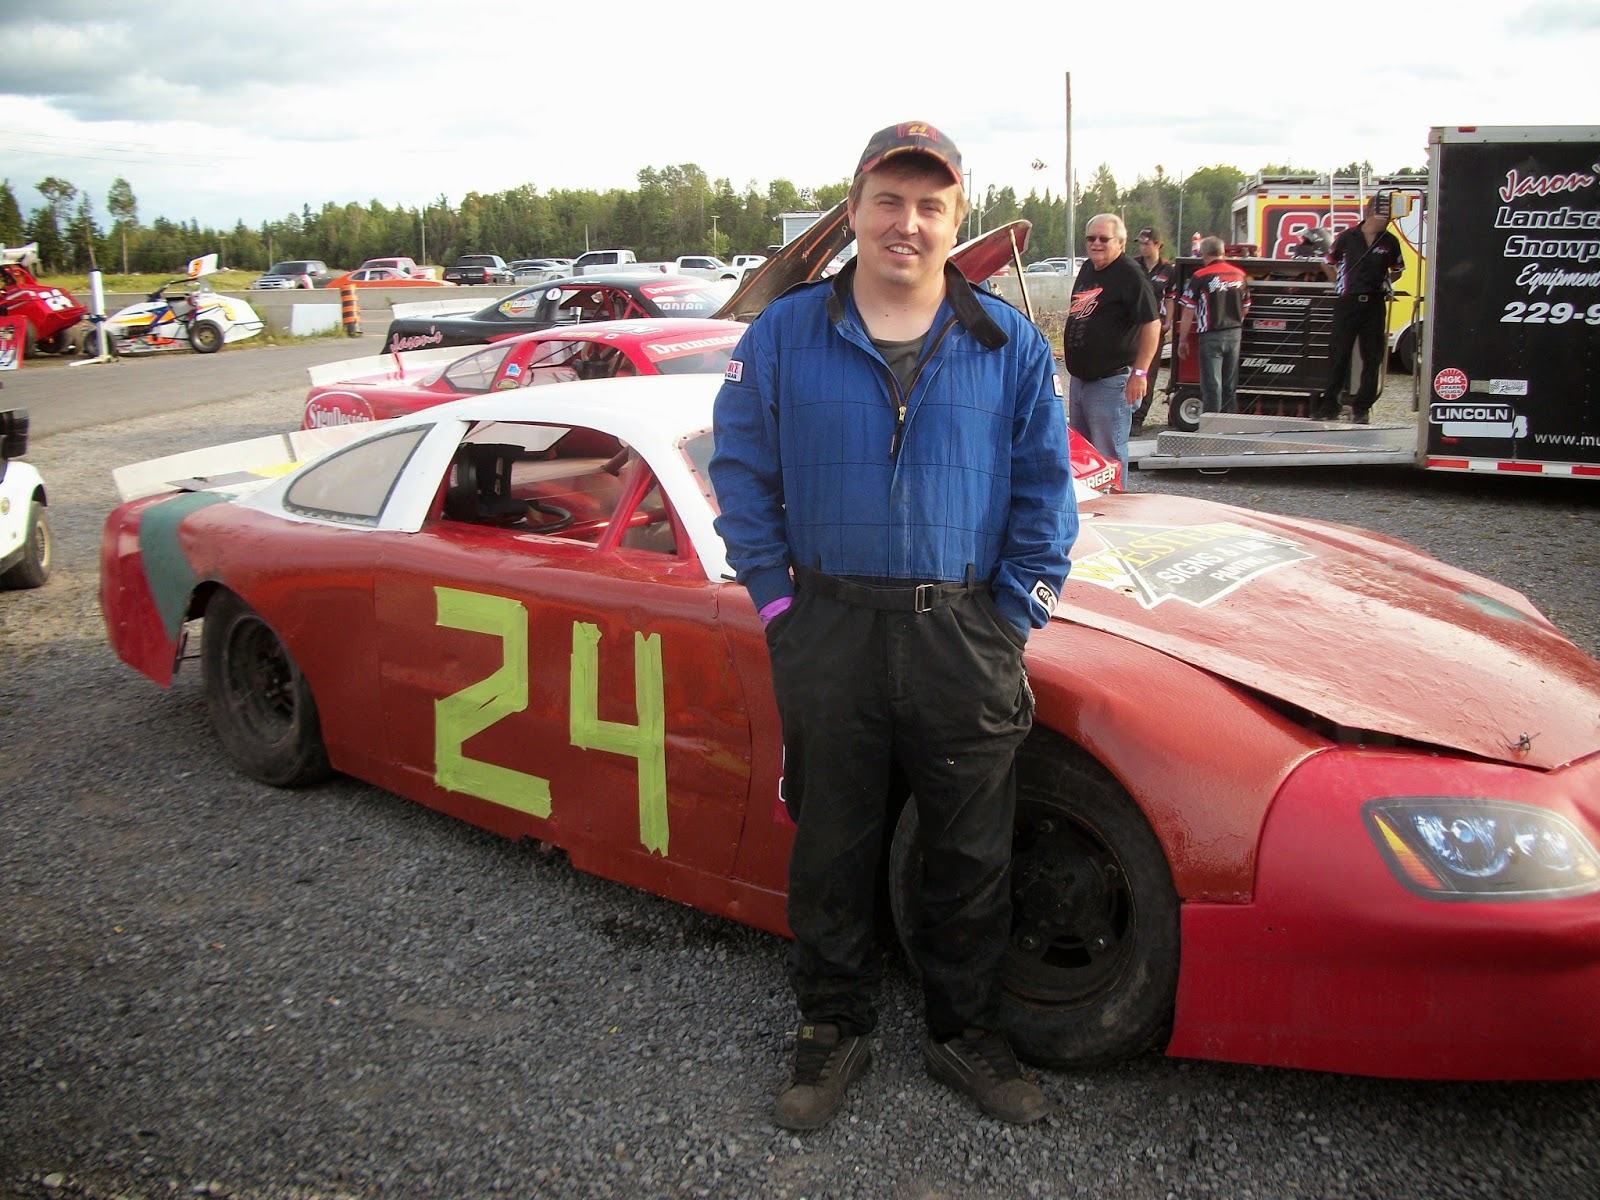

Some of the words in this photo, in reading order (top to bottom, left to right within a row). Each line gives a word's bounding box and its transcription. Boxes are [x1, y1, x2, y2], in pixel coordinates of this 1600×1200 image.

[1494, 206, 1600, 229] Landsc
[1272, 297, 1312, 306] DODGE
[1241, 357, 1271, 368] BEAT
[1440, 376, 1461, 384] NGK
[1436, 408, 1508, 420] LINCOLN
[1156, 551, 1225, 584] SIGNS
[434, 585, 670, 858] 24
